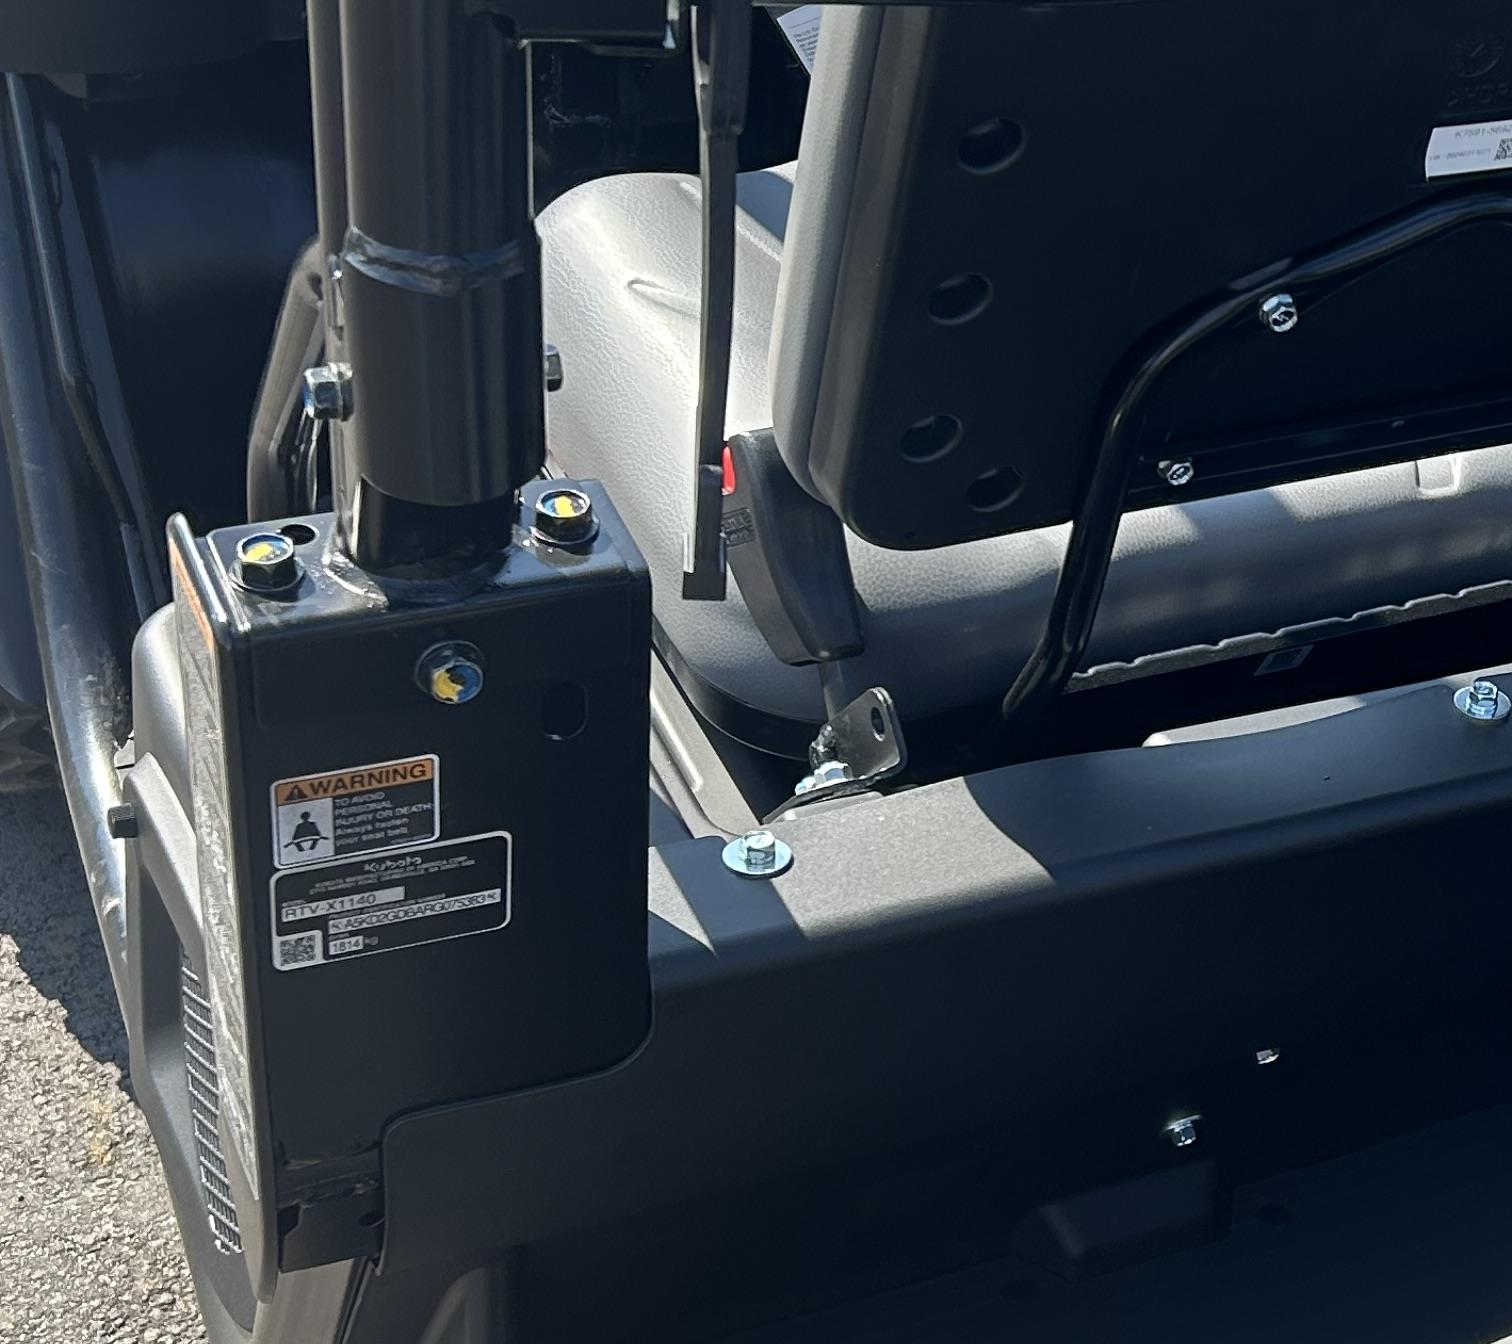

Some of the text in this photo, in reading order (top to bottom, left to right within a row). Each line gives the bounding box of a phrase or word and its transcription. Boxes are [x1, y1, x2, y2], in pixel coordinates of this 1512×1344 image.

[309, 763, 426, 795] WARNING
[351, 792, 385, 805] AVOID
[335, 800, 392, 816] PERSONAL
[335, 813, 374, 827] INJURY
[375, 810, 393, 819] OR
[335, 818, 409, 836] Always fasten
[335, 836, 359, 847] your
[361, 831, 385, 841] seat
[364, 856, 422, 872] Kubota
[284, 893, 376, 920] RTV-X1140
[332, 939, 361, 952] 1814
